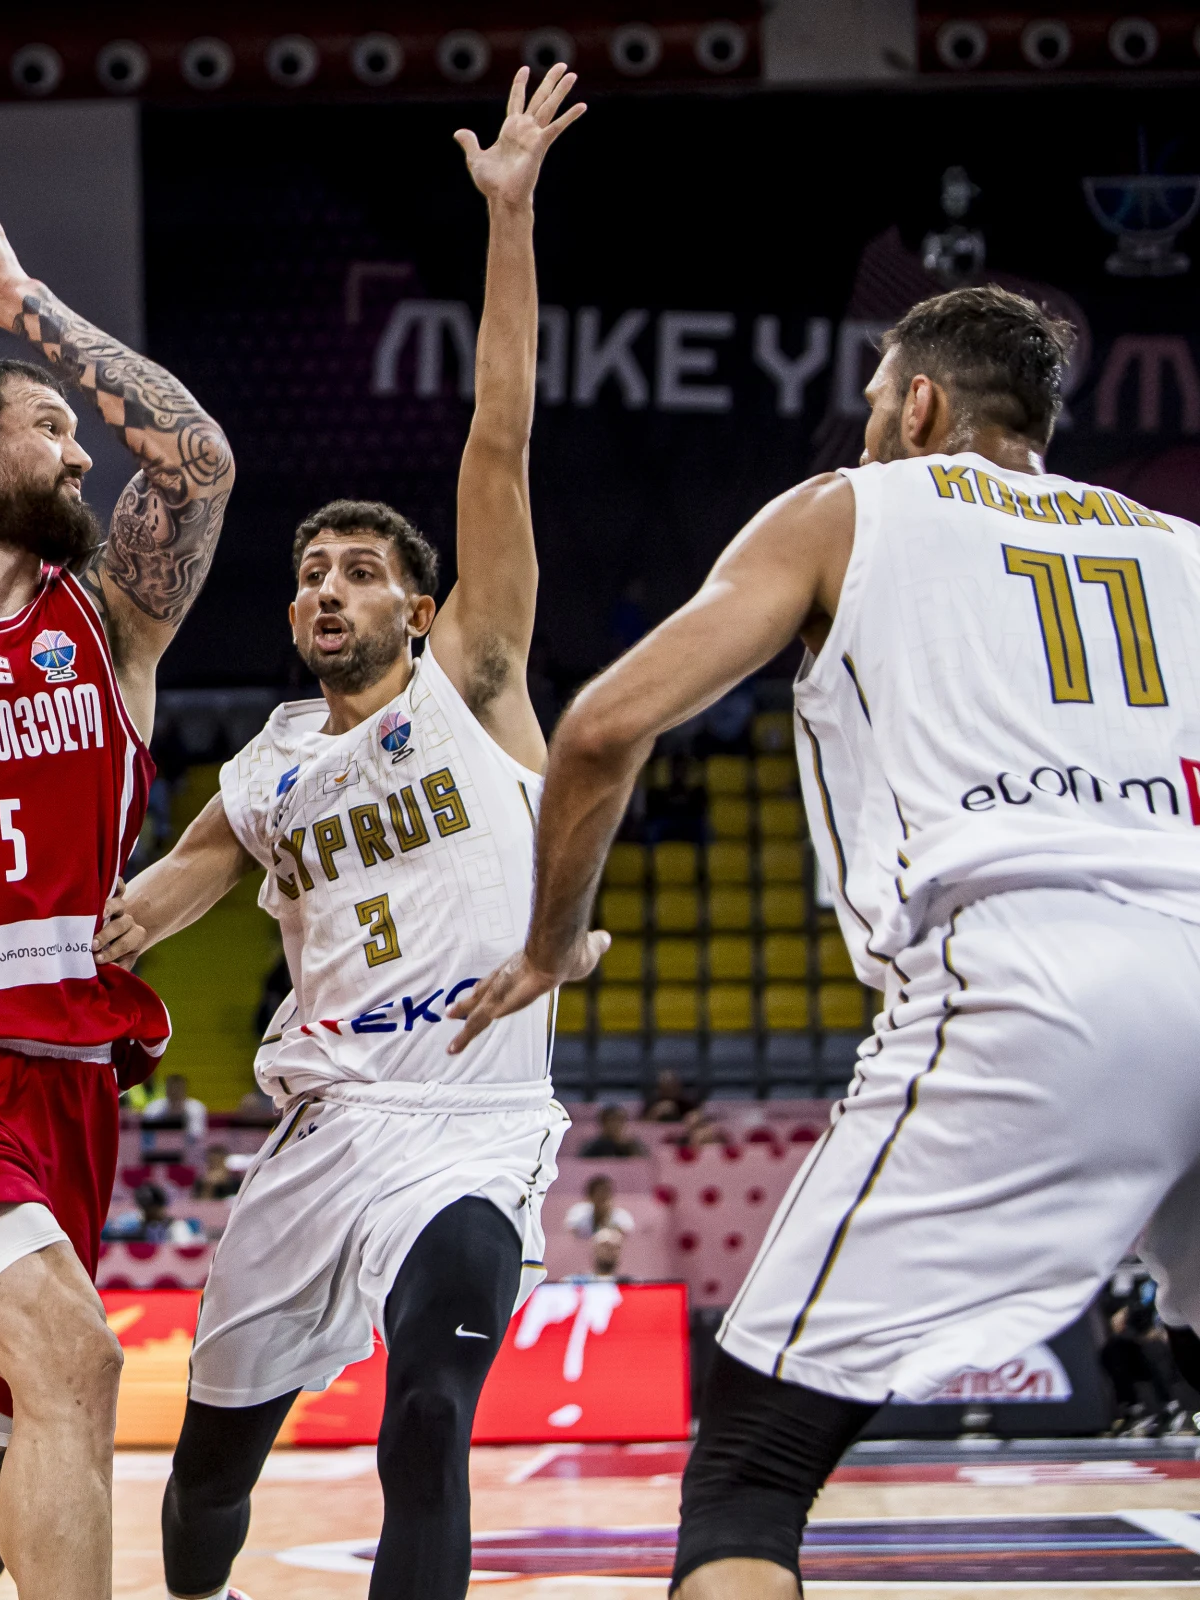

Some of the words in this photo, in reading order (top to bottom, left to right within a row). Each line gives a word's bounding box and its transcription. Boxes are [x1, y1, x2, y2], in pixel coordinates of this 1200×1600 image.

[926, 463, 1175, 534] KOUMIS
[1000, 542, 1170, 708] 11
[961, 766, 1200, 816] ecomm
[65, 942, 93, 953] ბან
[354, 892, 403, 969] 3
